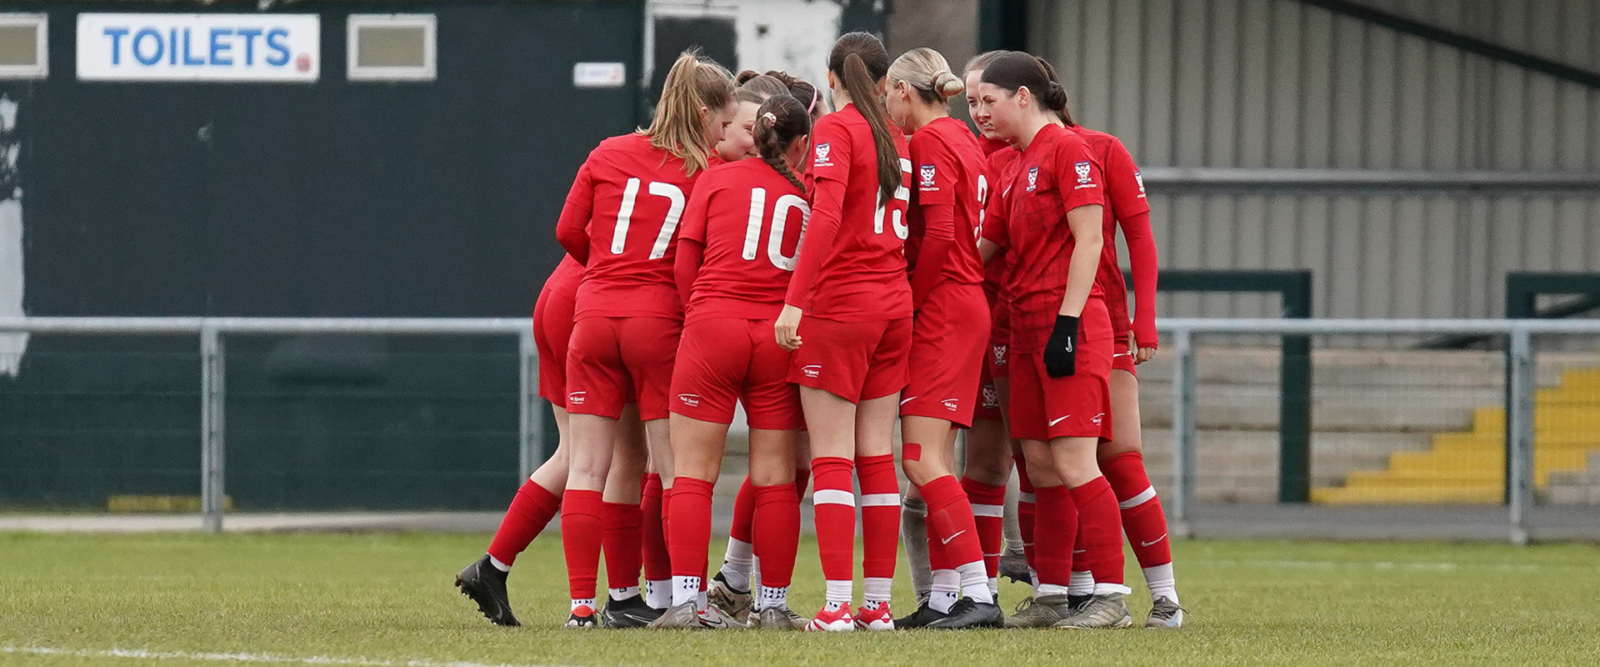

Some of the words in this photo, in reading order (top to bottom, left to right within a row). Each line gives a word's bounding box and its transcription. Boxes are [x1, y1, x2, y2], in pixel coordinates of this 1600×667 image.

[103, 27, 291, 66] TOILETS
[611, 177, 686, 260] 17
[742, 187, 811, 271] 10
[874, 157, 912, 240] 15
